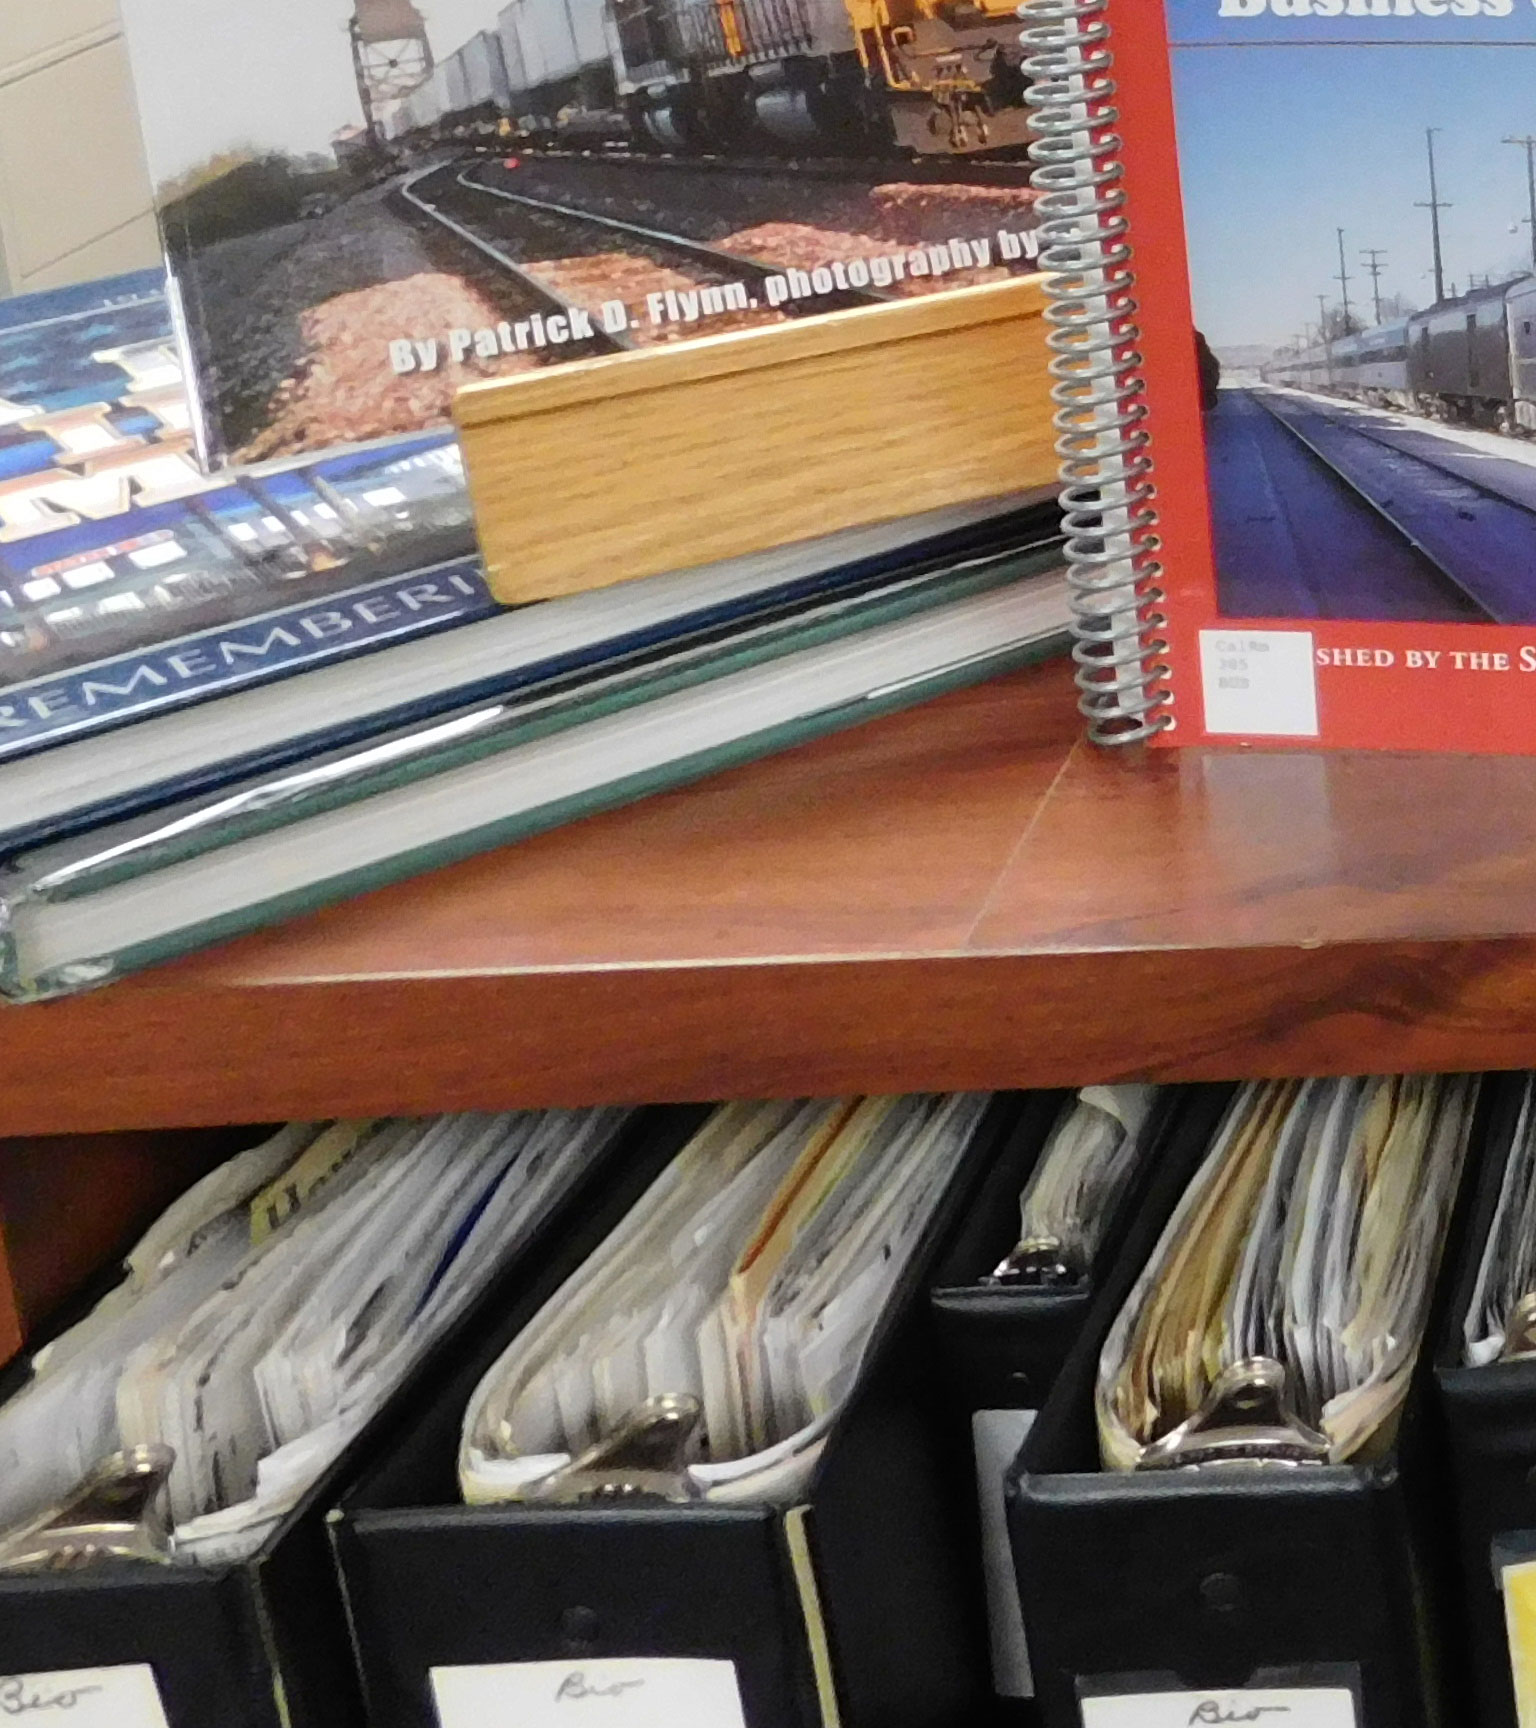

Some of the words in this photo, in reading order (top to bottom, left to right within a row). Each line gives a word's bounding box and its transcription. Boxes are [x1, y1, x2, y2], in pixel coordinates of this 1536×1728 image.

[388, 336, 440, 373] By
[450, 306, 595, 363] Patrick
[600, 299, 640, 335] D.
[764, 237, 992, 307] photography
[998, 229, 1040, 260] by
[1405, 648, 1441, 669] BY
[1449, 650, 1509, 671] THE
